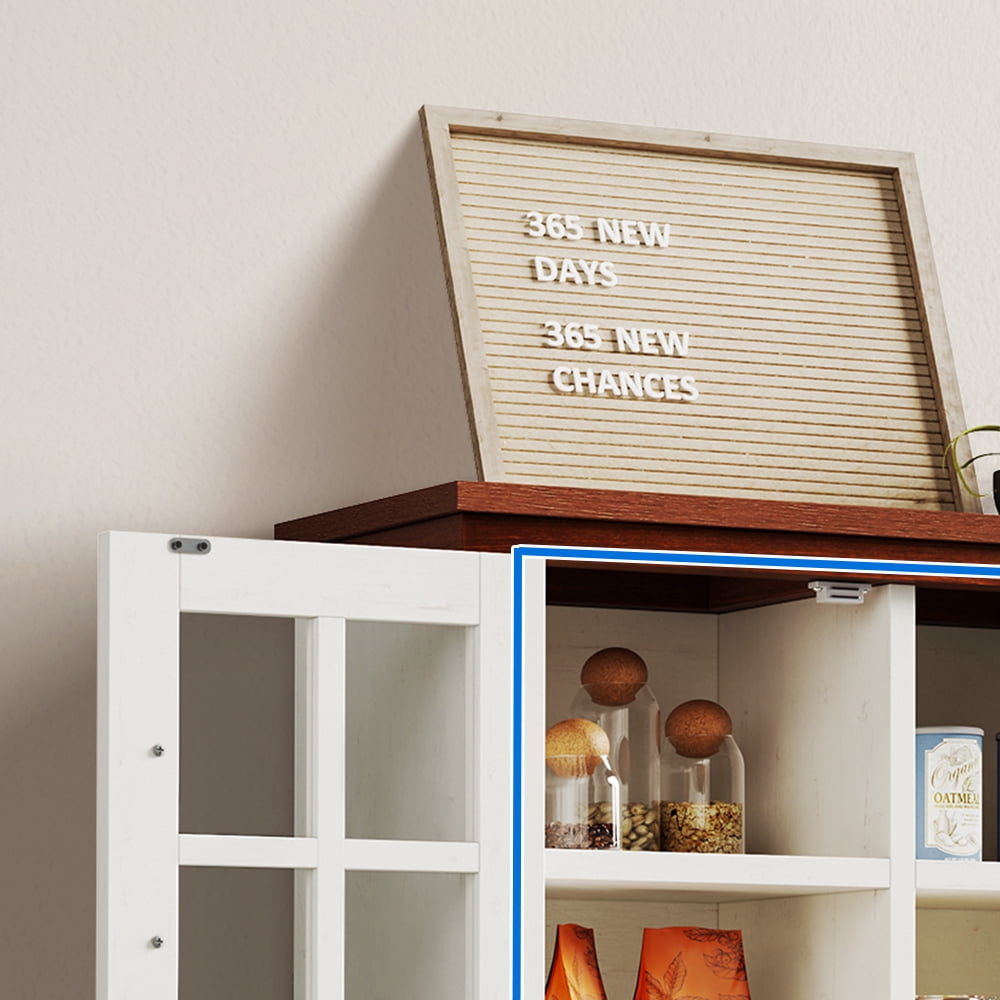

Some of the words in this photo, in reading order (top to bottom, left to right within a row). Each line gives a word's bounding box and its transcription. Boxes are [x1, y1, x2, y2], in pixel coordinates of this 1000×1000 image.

[525, 211, 584, 241] 365
[596, 217, 671, 248] NEW
[533, 255, 619, 288] DAYS
[544, 320, 603, 350] 365
[615, 326, 690, 357] NEW
[552, 366, 700, 401] CHANCES
[930, 757, 979, 790] Organi
